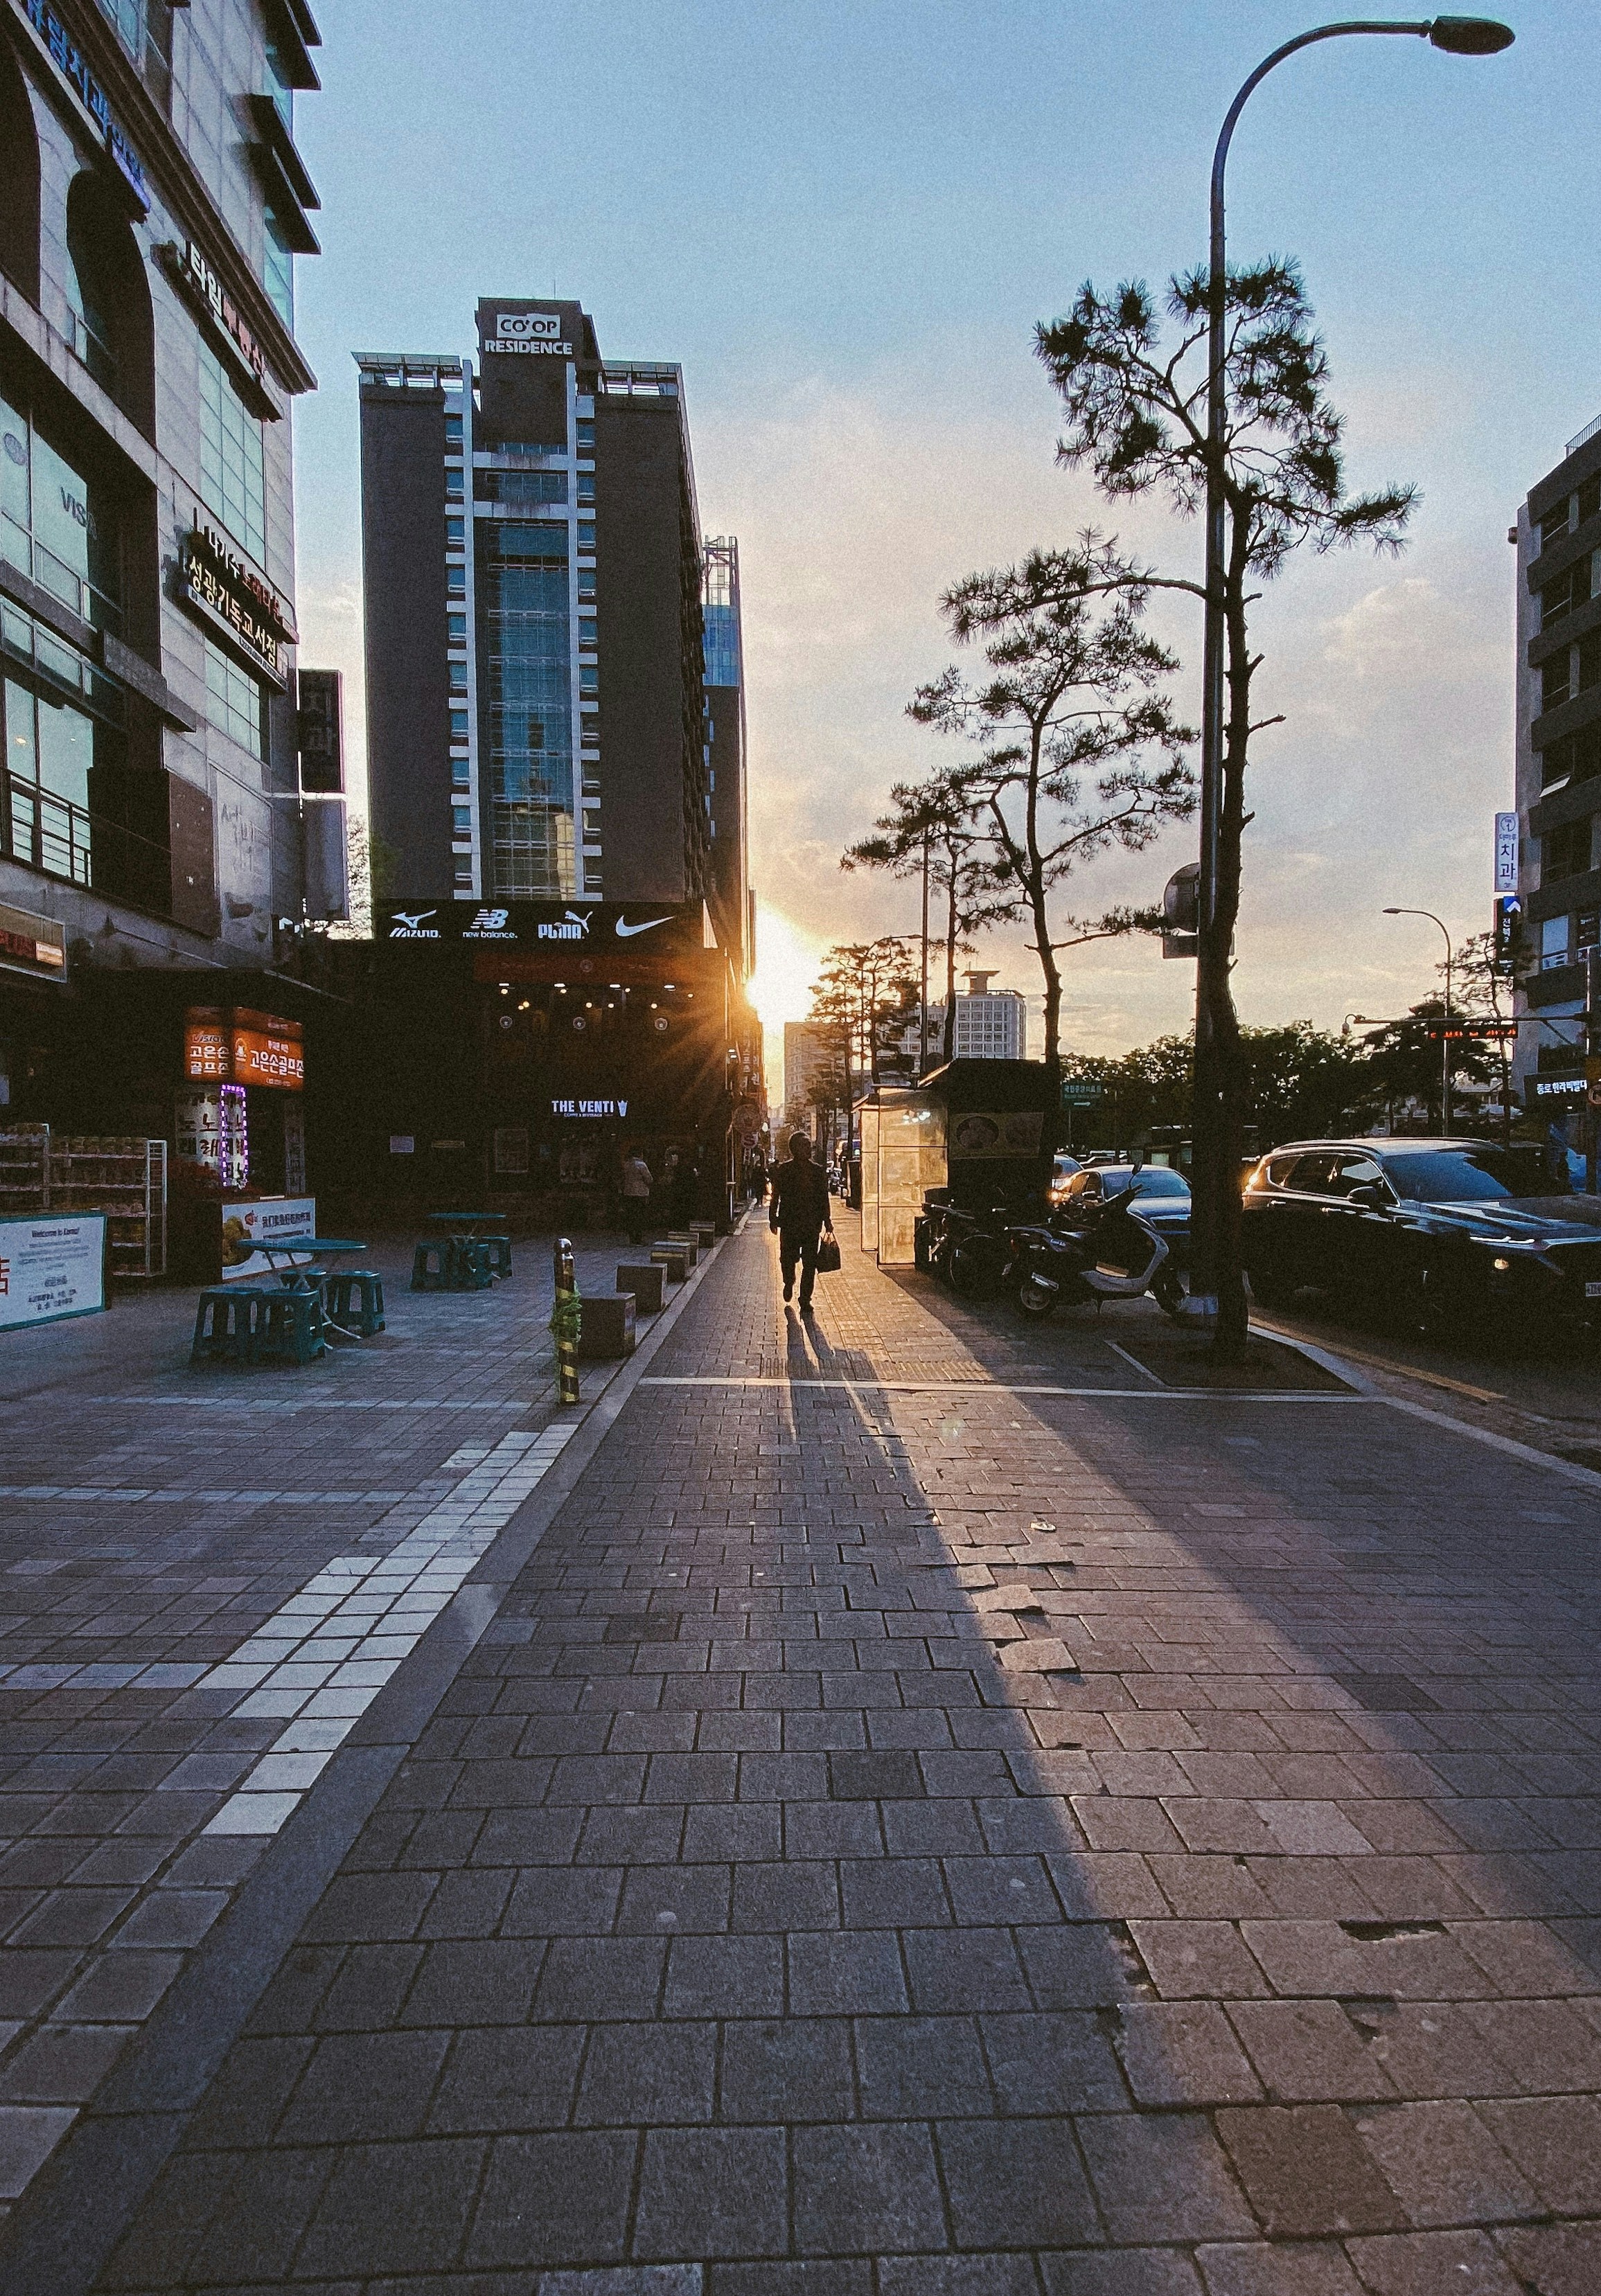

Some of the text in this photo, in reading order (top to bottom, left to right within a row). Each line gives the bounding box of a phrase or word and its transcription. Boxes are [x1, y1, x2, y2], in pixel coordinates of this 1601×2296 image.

[190, 242, 222, 318] 타임
[485, 339, 573, 355] RESIDENCE
[189, 555, 276, 668] 성광기독교서점
[1500, 843, 1516, 880] 치과
[389, 927, 439, 938] MIZUNO
[481, 930, 515, 938] balance
[538, 924, 582, 939] PUMA
[551, 1100, 614, 1113] THE VENTI
